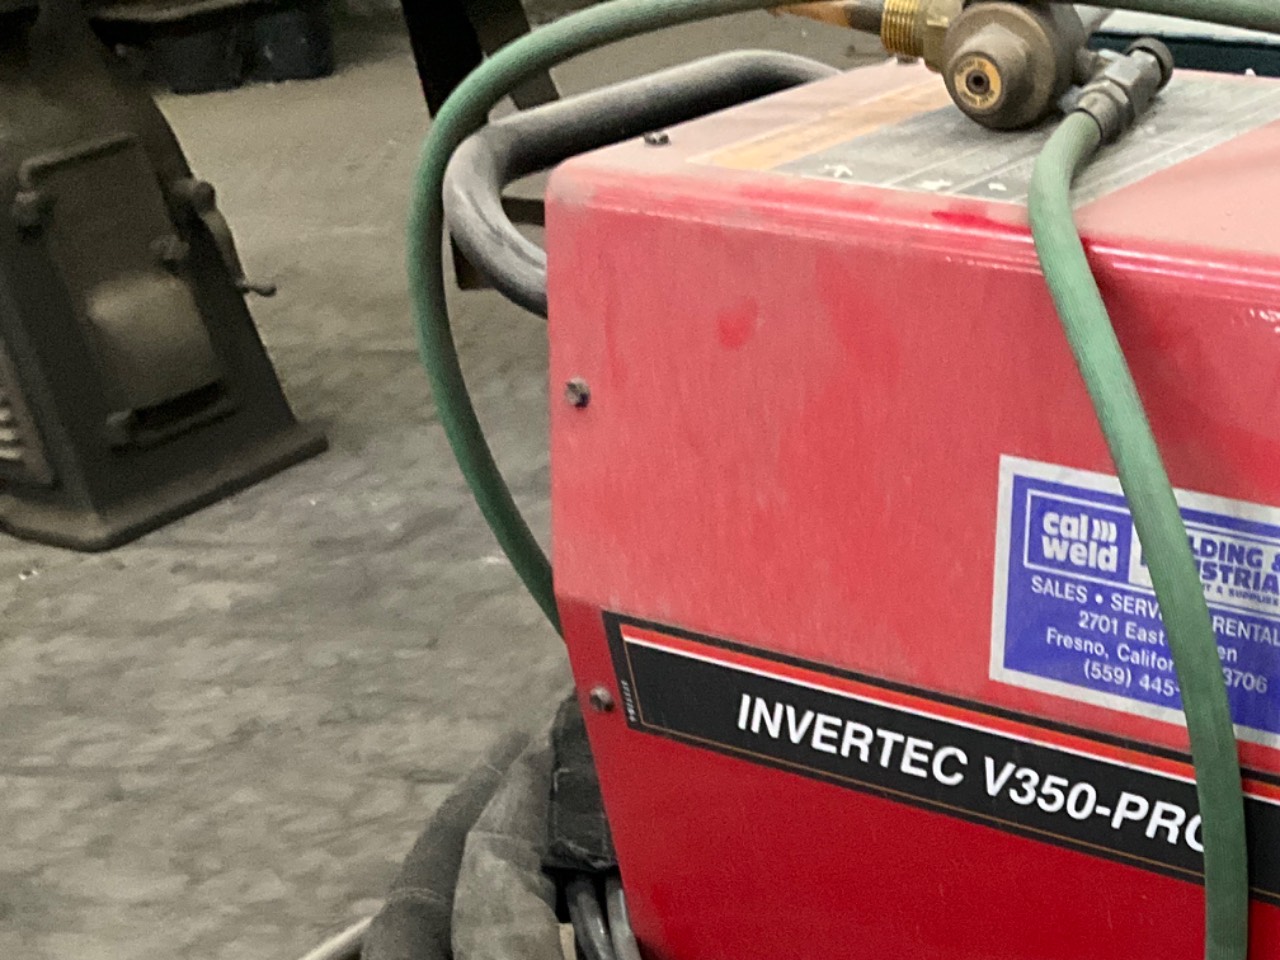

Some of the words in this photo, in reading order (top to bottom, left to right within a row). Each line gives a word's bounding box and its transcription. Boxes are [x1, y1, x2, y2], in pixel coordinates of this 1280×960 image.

[1042, 511, 1088, 542] cal
[1042, 536, 1118, 574] weld
[1189, 536, 1263, 570] LDING
[1031, 575, 1088, 604] SALES
[1110, 594, 1163, 622] SERV
[1078, 610, 1119, 636] 2701
[1125, 622, 1165, 647] East
[1046, 627, 1110, 660] Fresno,
[1117, 643, 1175, 673] Califor
[1223, 668, 1268, 694] 3706
[1084, 658, 1132, 690] (559)
[736, 693, 968, 787] INVERTEC
